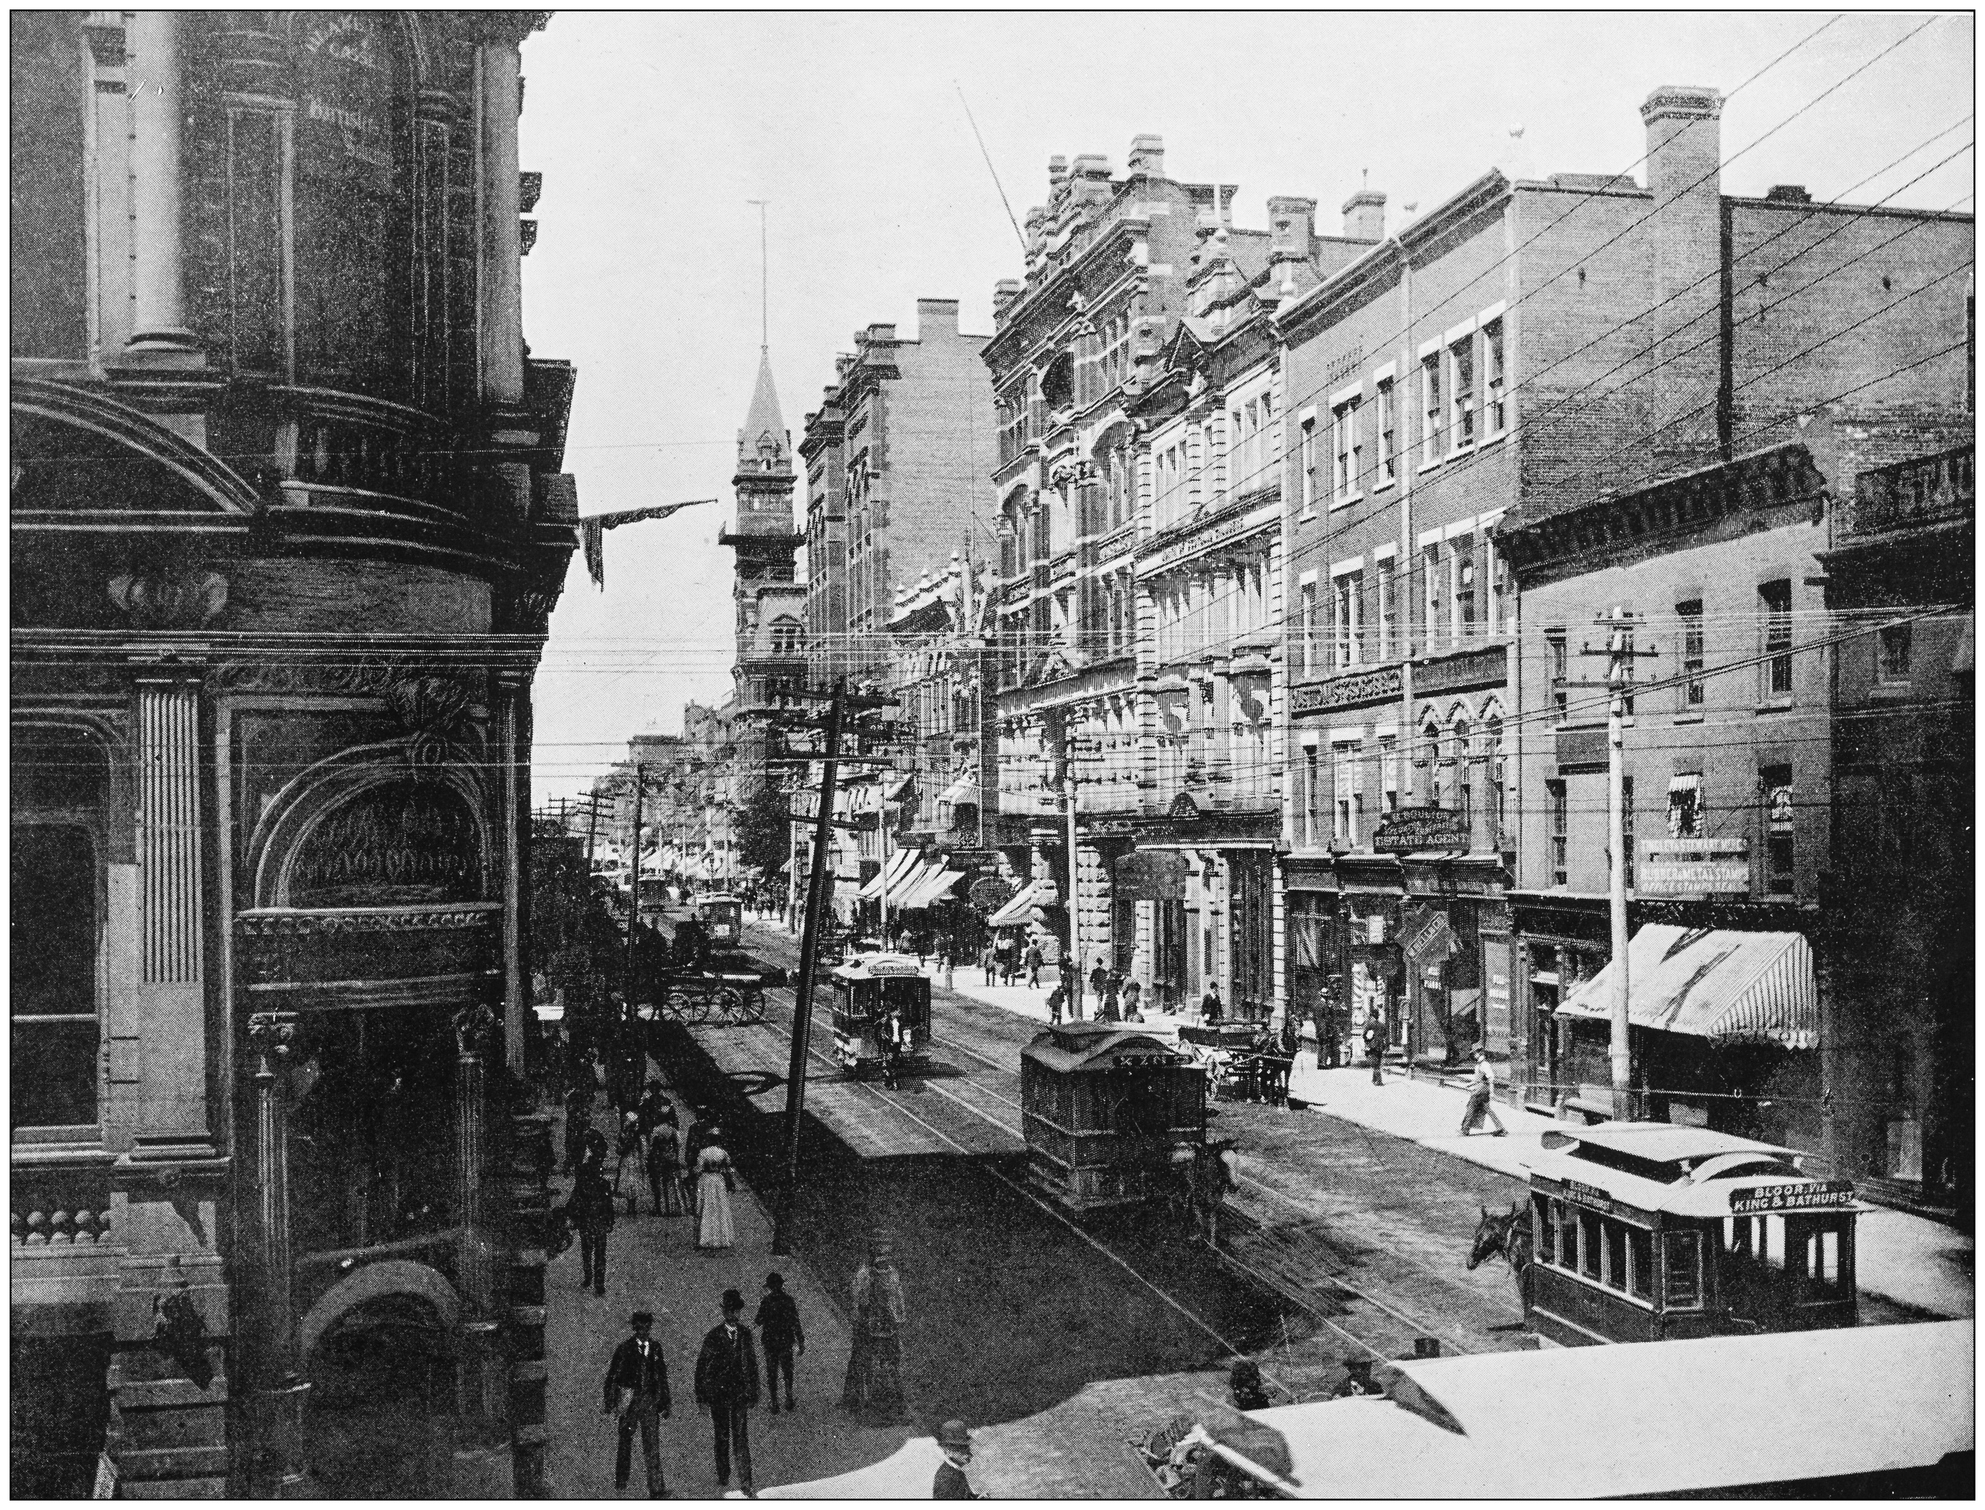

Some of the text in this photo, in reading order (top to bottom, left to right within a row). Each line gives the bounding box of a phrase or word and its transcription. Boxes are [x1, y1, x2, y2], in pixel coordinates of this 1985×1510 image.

[1375, 833, 1469, 846] ESTATE AGENT
[1640, 867, 1678, 881] RUBBER
[1682, 867, 1715, 880] METAL
[1733, 1191, 1853, 1212] KING & BATHURST
